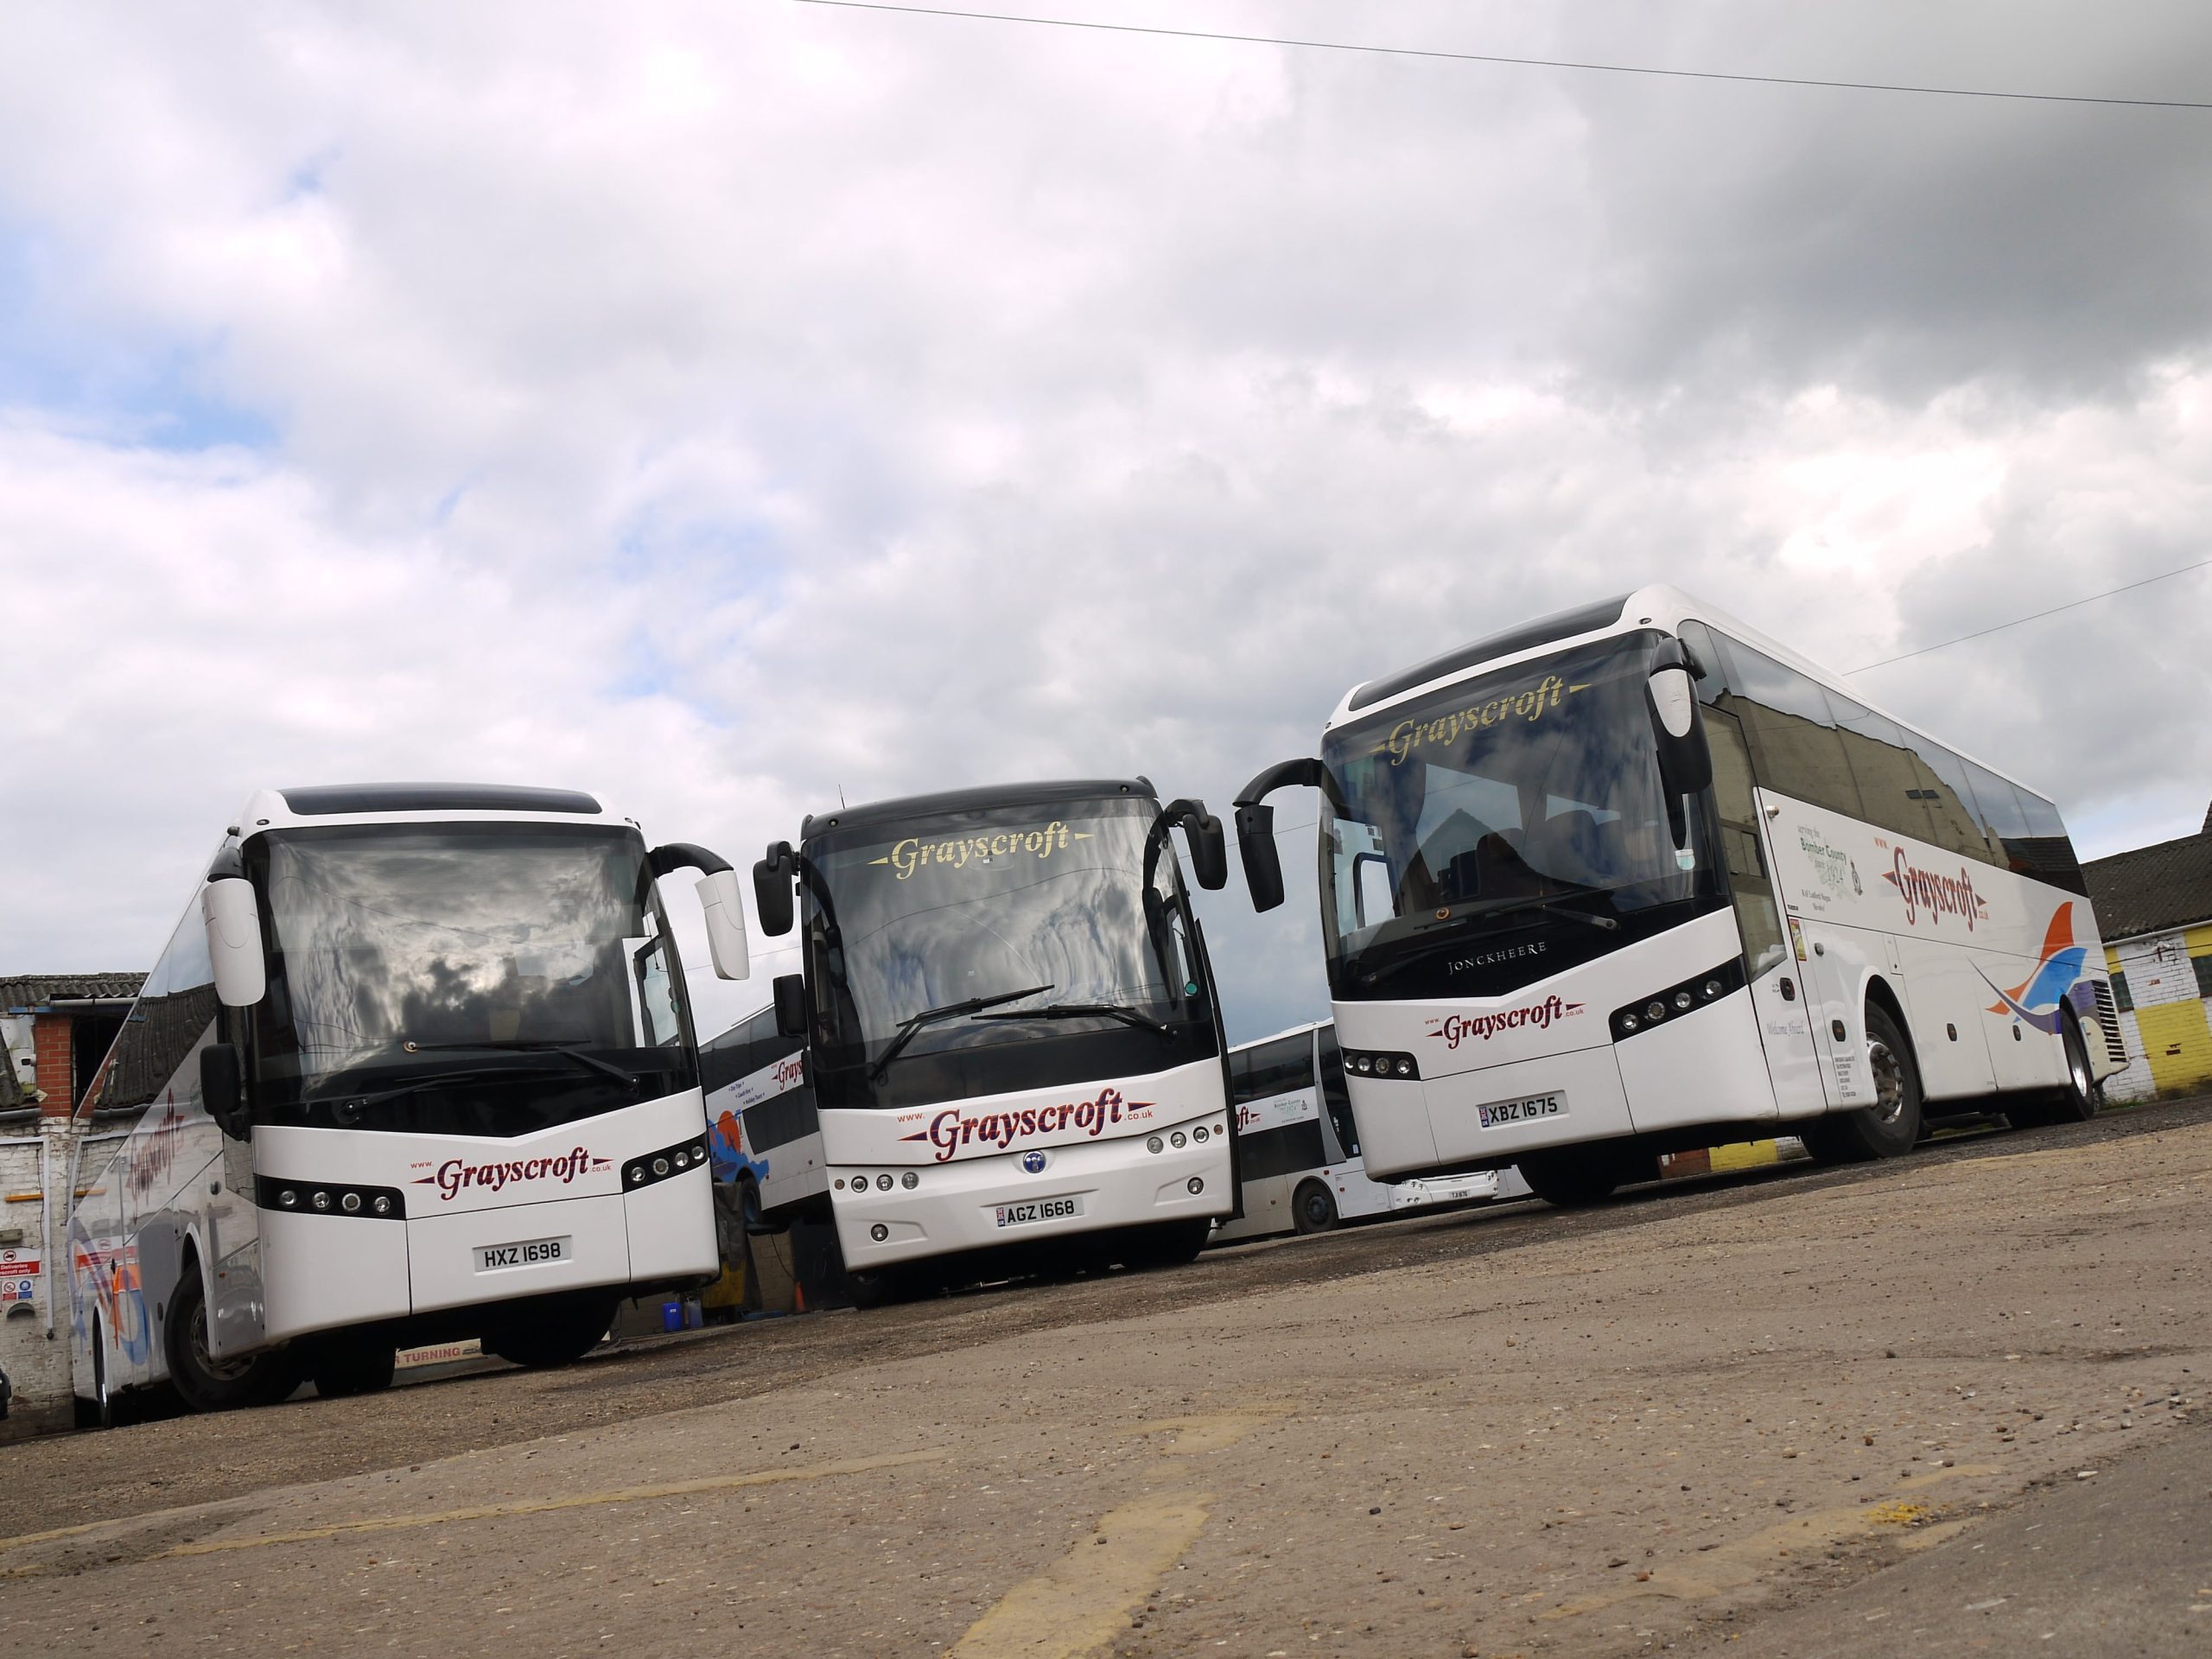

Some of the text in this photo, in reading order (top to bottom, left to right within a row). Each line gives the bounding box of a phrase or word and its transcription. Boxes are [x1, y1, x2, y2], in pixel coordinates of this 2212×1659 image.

[1388, 675, 1563, 766] Grayscroft
[891, 820, 1070, 880] Grayscroft
[1800, 837, 1847, 866] Bomber County
[1893, 846, 1978, 932] Grayscroft
[1448, 941, 1547, 976] JONCKHEERE
[1443, 995, 1563, 1050] Grayscroft
[897, 1088, 1154, 1162] www. Grayscroft .co.uk
[1489, 1096, 1558, 1123] XBZ 1675
[410, 1147, 612, 1200] www. Grayscroft .co.uk
[1007, 1199, 1075, 1224] AGZ 1668
[484, 1242, 562, 1268] HXZ 1698
[404, 1347, 461, 1363] TURNING
